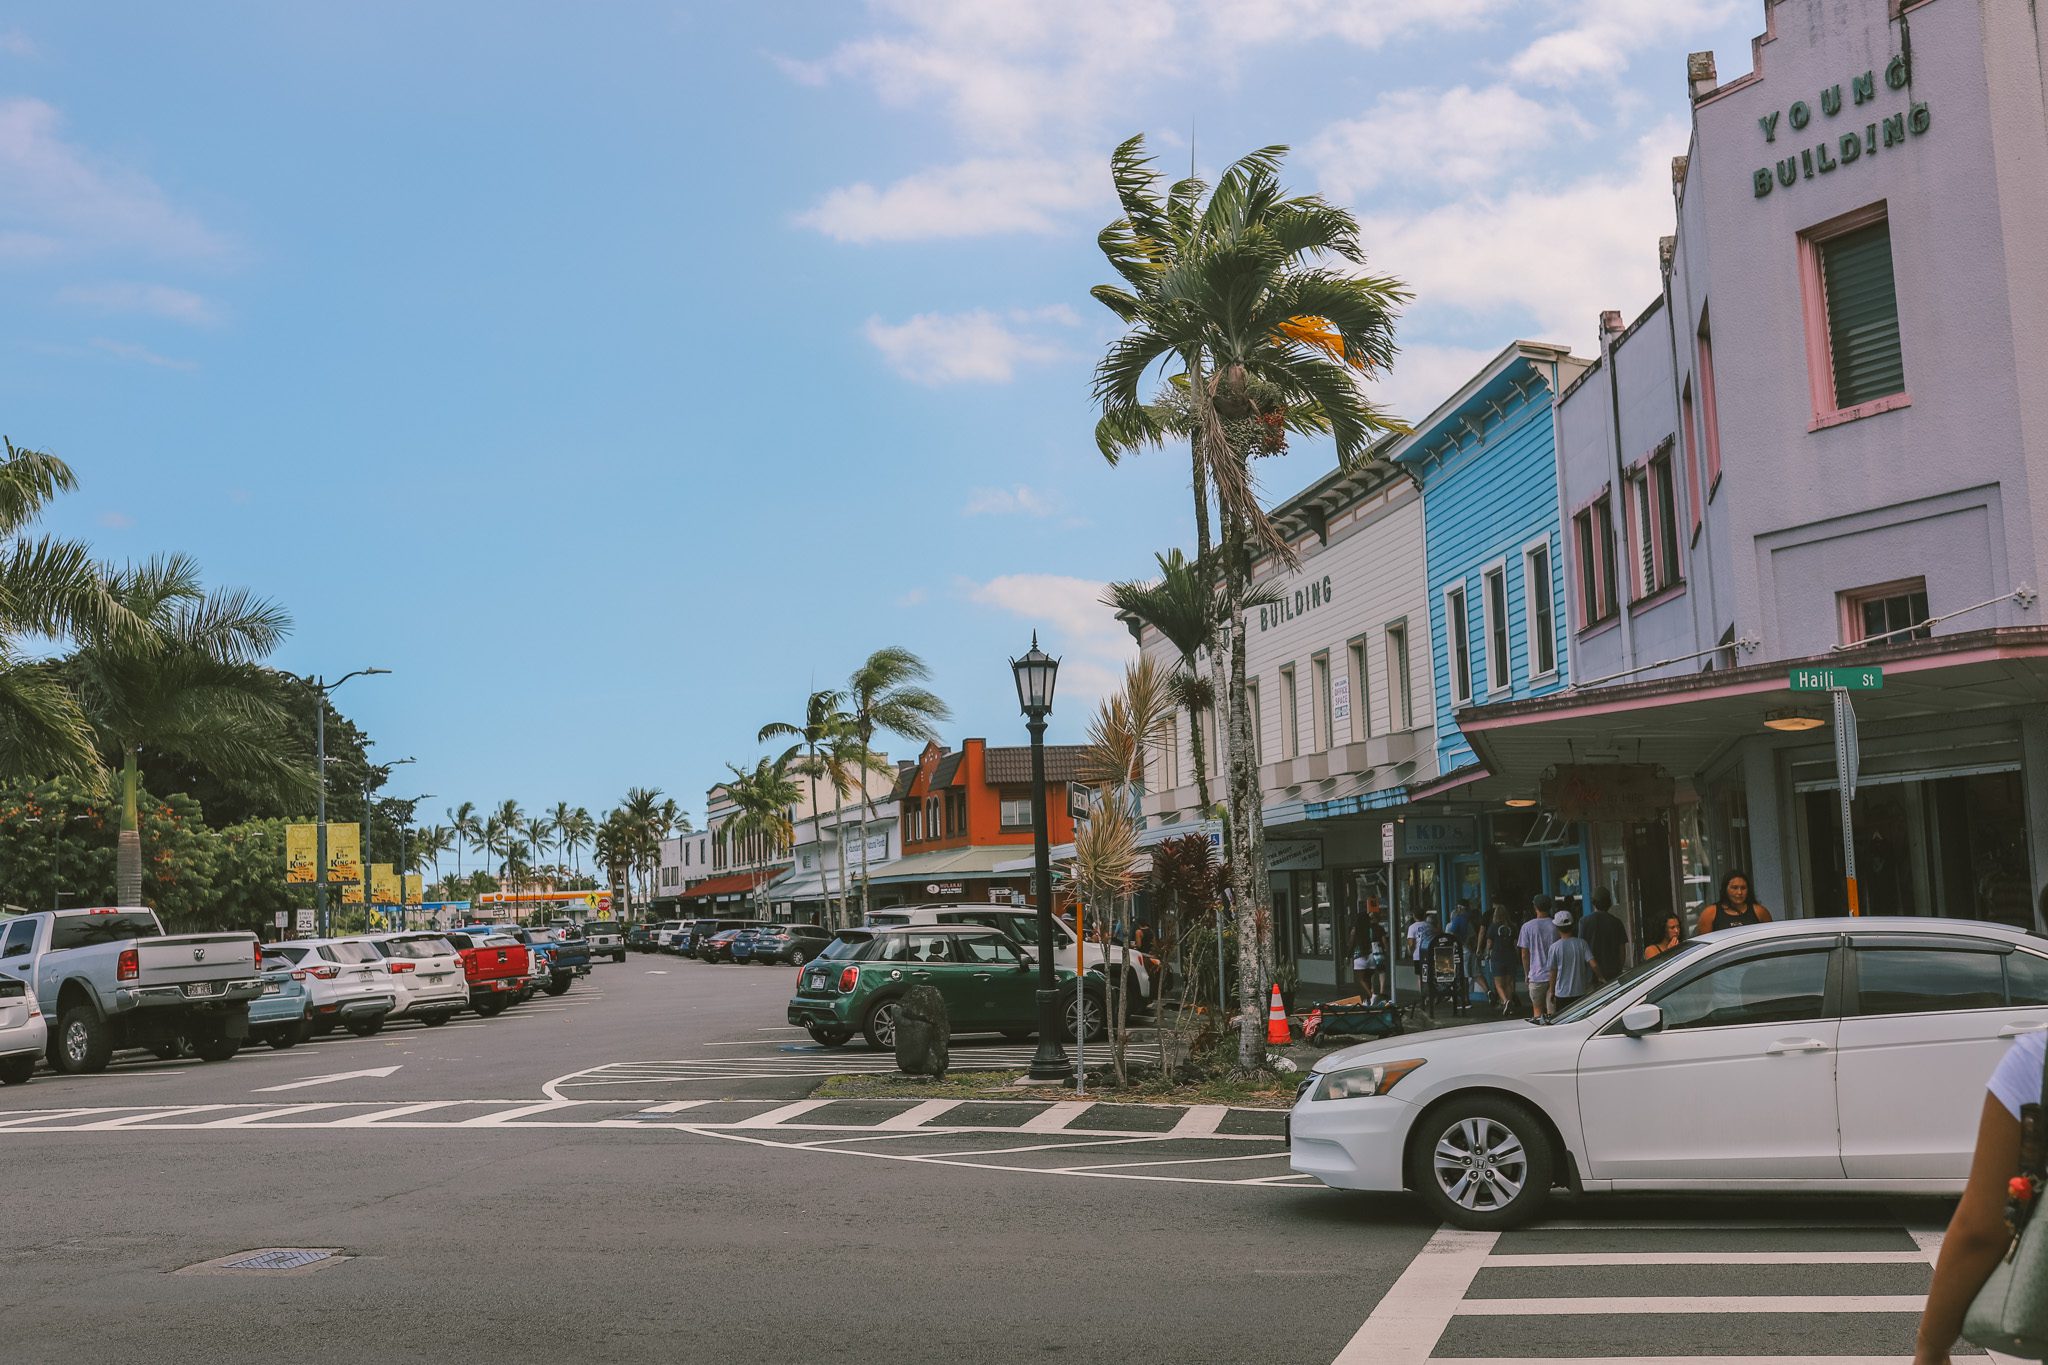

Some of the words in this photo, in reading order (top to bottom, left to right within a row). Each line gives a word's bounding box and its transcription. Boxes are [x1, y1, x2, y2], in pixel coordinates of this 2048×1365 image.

[1758, 55, 1910, 143] YOUNG
[1752, 103, 1932, 199] BUILDING
[1260, 575, 1332, 632] BUILDING
[1799, 671, 1834, 688] Haili
[1862, 673, 1875, 687] St
[1334, 685, 1348, 697] OFFICE
[1335, 694, 1348, 706] SPACE
[298, 920, 312, 928] 25
